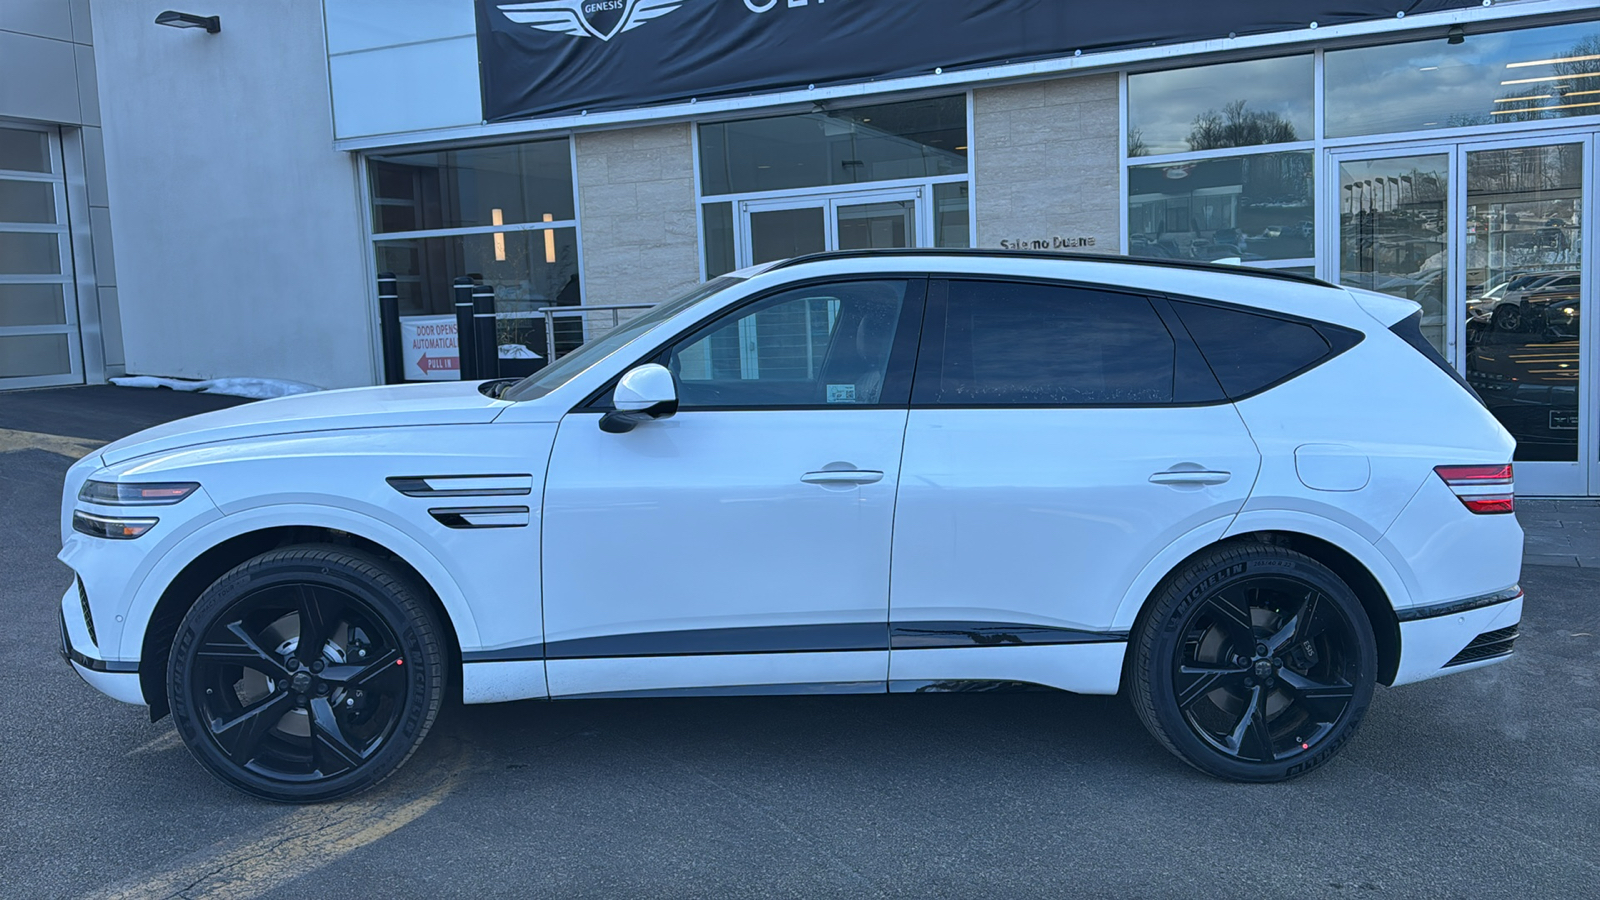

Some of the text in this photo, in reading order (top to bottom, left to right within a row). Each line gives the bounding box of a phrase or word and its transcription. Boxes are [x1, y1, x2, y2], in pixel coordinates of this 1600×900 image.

[585, 0, 623, 13] GENESIS
[1053, 236, 1096, 249] Duane
[416, 323, 458, 336] DOOR OPENS
[412, 338, 458, 350] AUTOMATICAL
[427, 358, 452, 369] PULL IN
[1177, 564, 1243, 616] MICHELIN
[1303, 640, 1315, 657] ESIS
[174, 631, 194, 717] MICHELIN
[406, 650, 426, 735] MICHELIN
